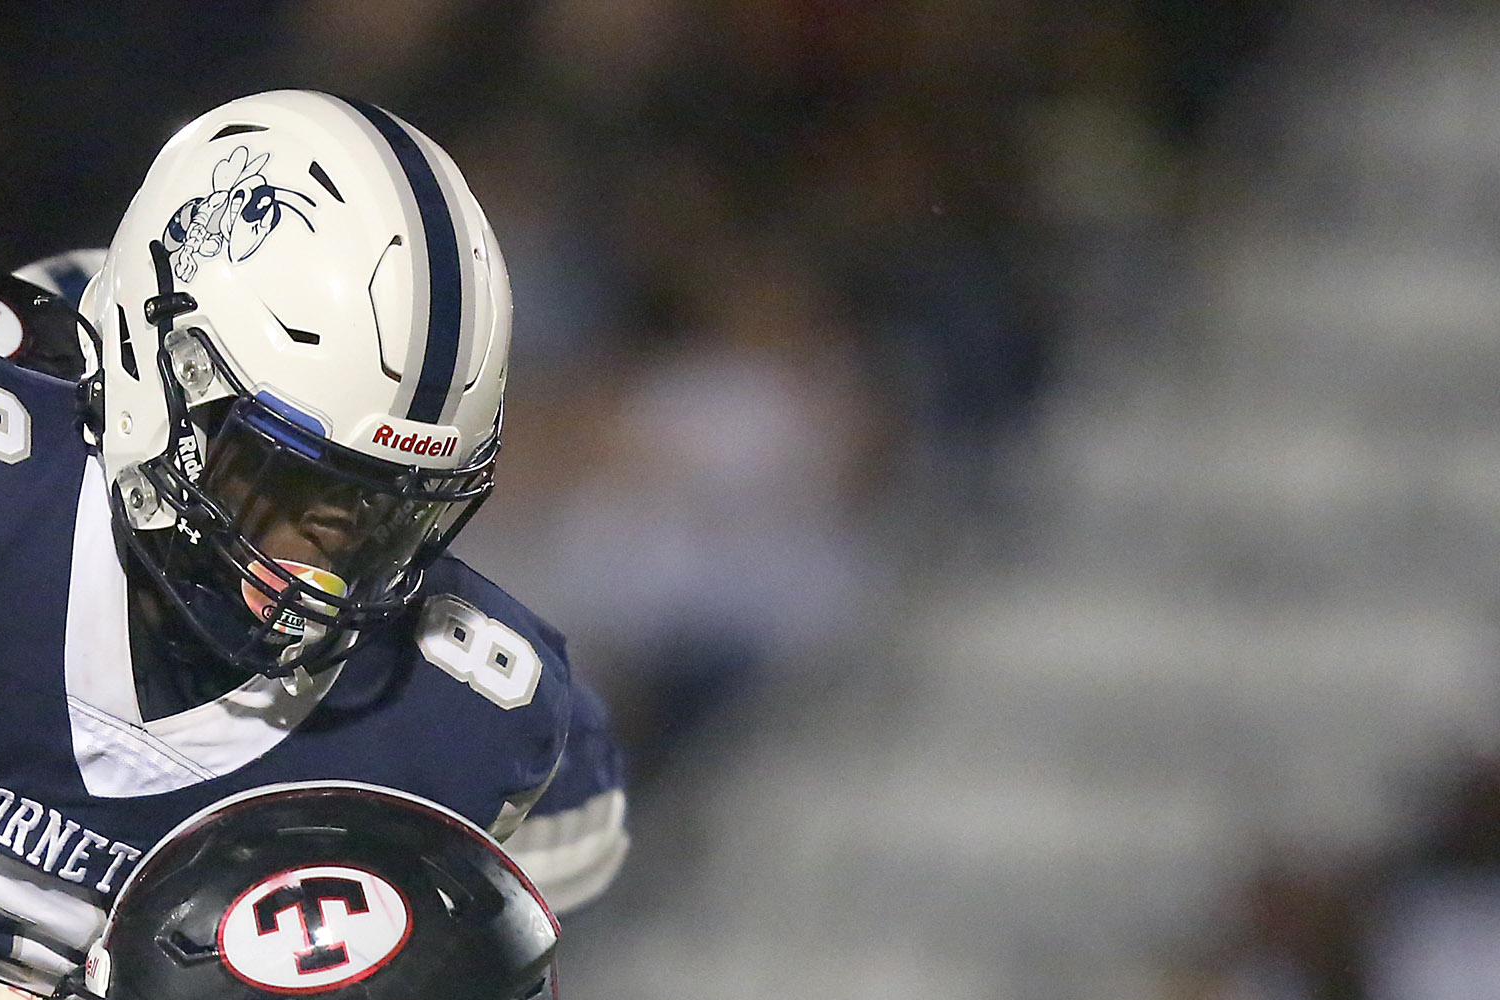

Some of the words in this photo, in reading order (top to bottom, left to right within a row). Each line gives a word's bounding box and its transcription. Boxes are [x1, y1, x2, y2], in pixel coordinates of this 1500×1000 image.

[372, 424, 459, 457] Riddell
[414, 593, 542, 707] 8
[252, 875, 370, 976] T
